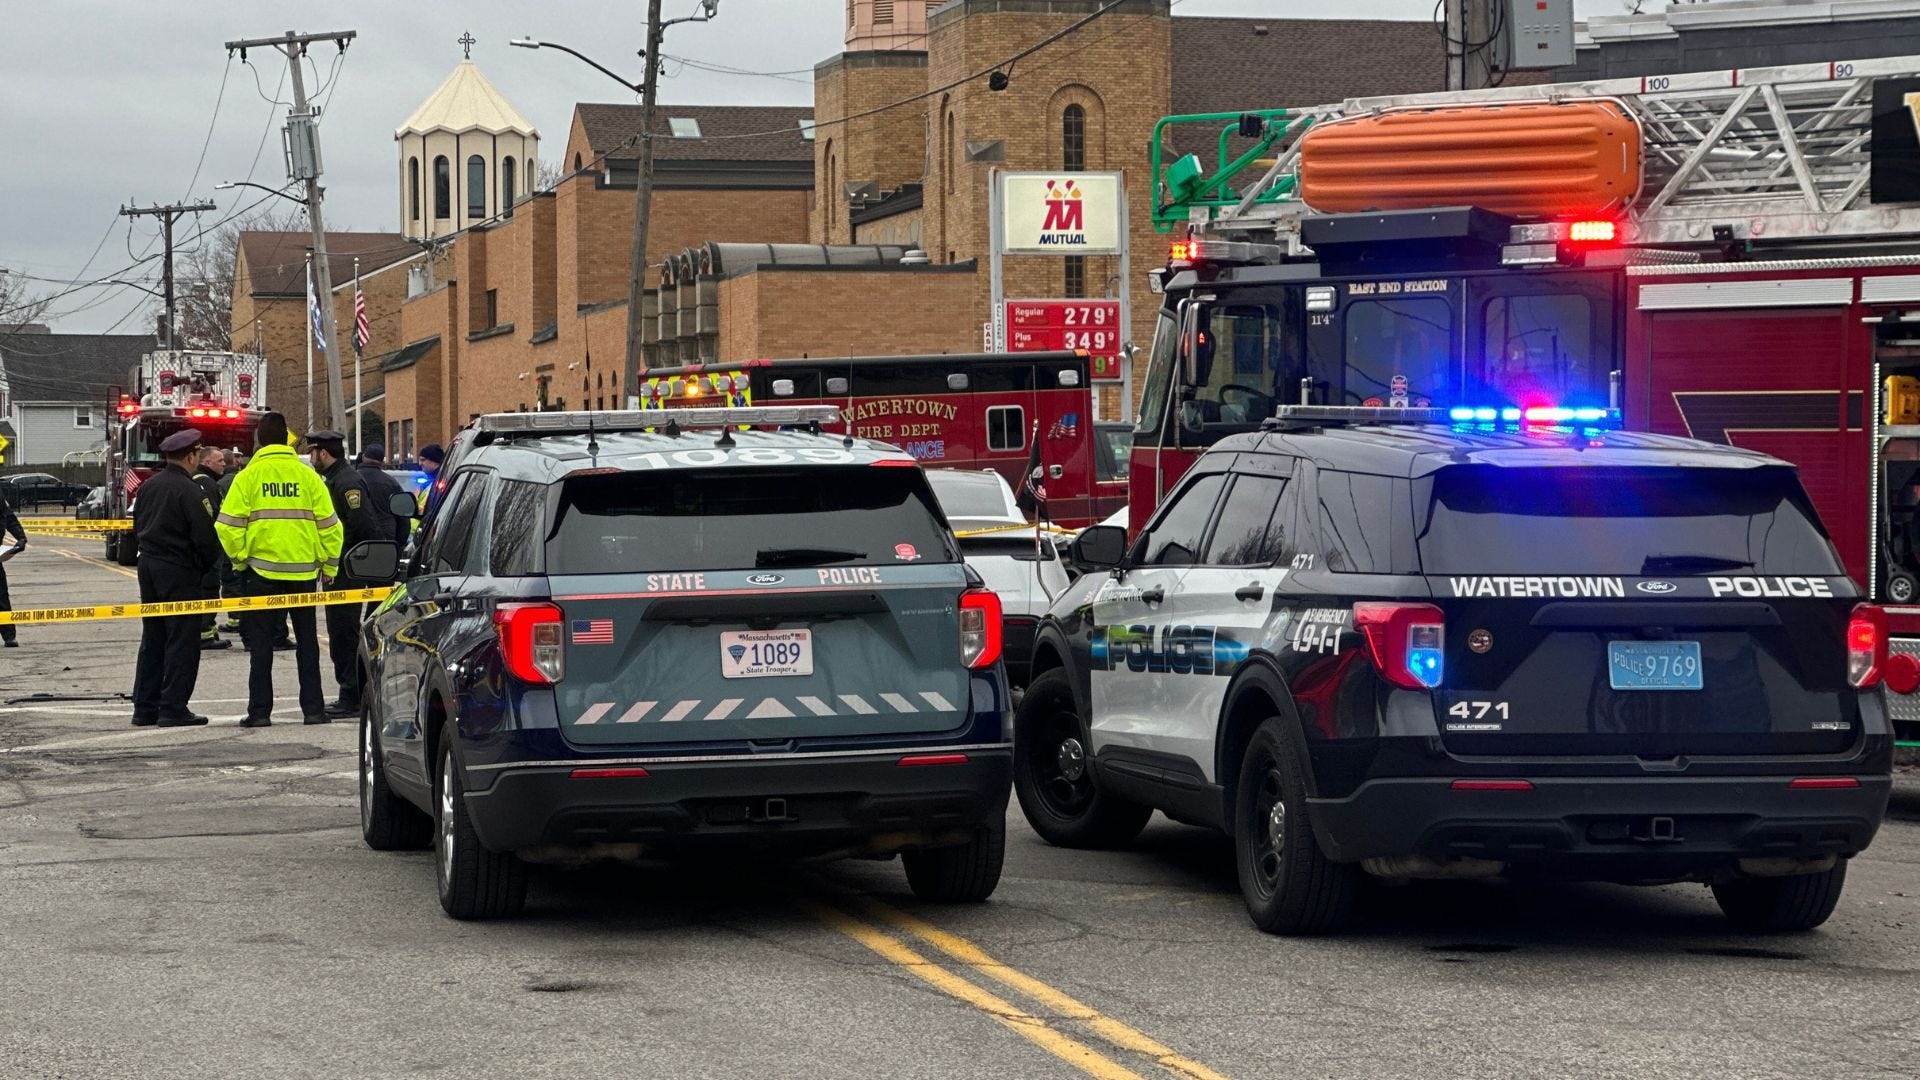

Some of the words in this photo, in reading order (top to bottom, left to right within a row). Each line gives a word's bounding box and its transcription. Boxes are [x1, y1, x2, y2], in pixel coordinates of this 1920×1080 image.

[1835, 63, 1853, 77] 90
[1648, 77, 1669, 91] 100
[1038, 233, 1087, 245] MUTUAL
[1348, 283, 1375, 294] EAST
[1378, 282, 1401, 293] END
[1404, 280, 1448, 292] STATION
[1015, 307, 1044, 317] Regular
[1015, 332, 1032, 341] Plus
[840, 399, 958, 423] WATERTOWN
[857, 425, 893, 438] FIRE
[901, 423, 942, 436] DEPT.
[627, 448, 856, 469] 1089
[262, 482, 300, 498] POLICE
[1291, 553, 1315, 570] 471
[647, 573, 706, 592] STATE
[817, 567, 882, 585] POLICE
[1450, 577, 1625, 598] WATERTOWN
[1709, 577, 1833, 598] POLICE
[1309, 608, 1349, 624] EMERGENCY
[742, 633, 791, 641] Massachusetts
[1299, 624, 1343, 655] 9-1-1
[751, 642, 801, 666] 1089
[1108, 624, 1217, 676] POLICE
[746, 666, 763, 674] State
[765, 666, 791, 674] Trooper
[1614, 652, 1644, 676] POLICE
[1645, 655, 1696, 677] 9769
[1449, 701, 1509, 719] 471
